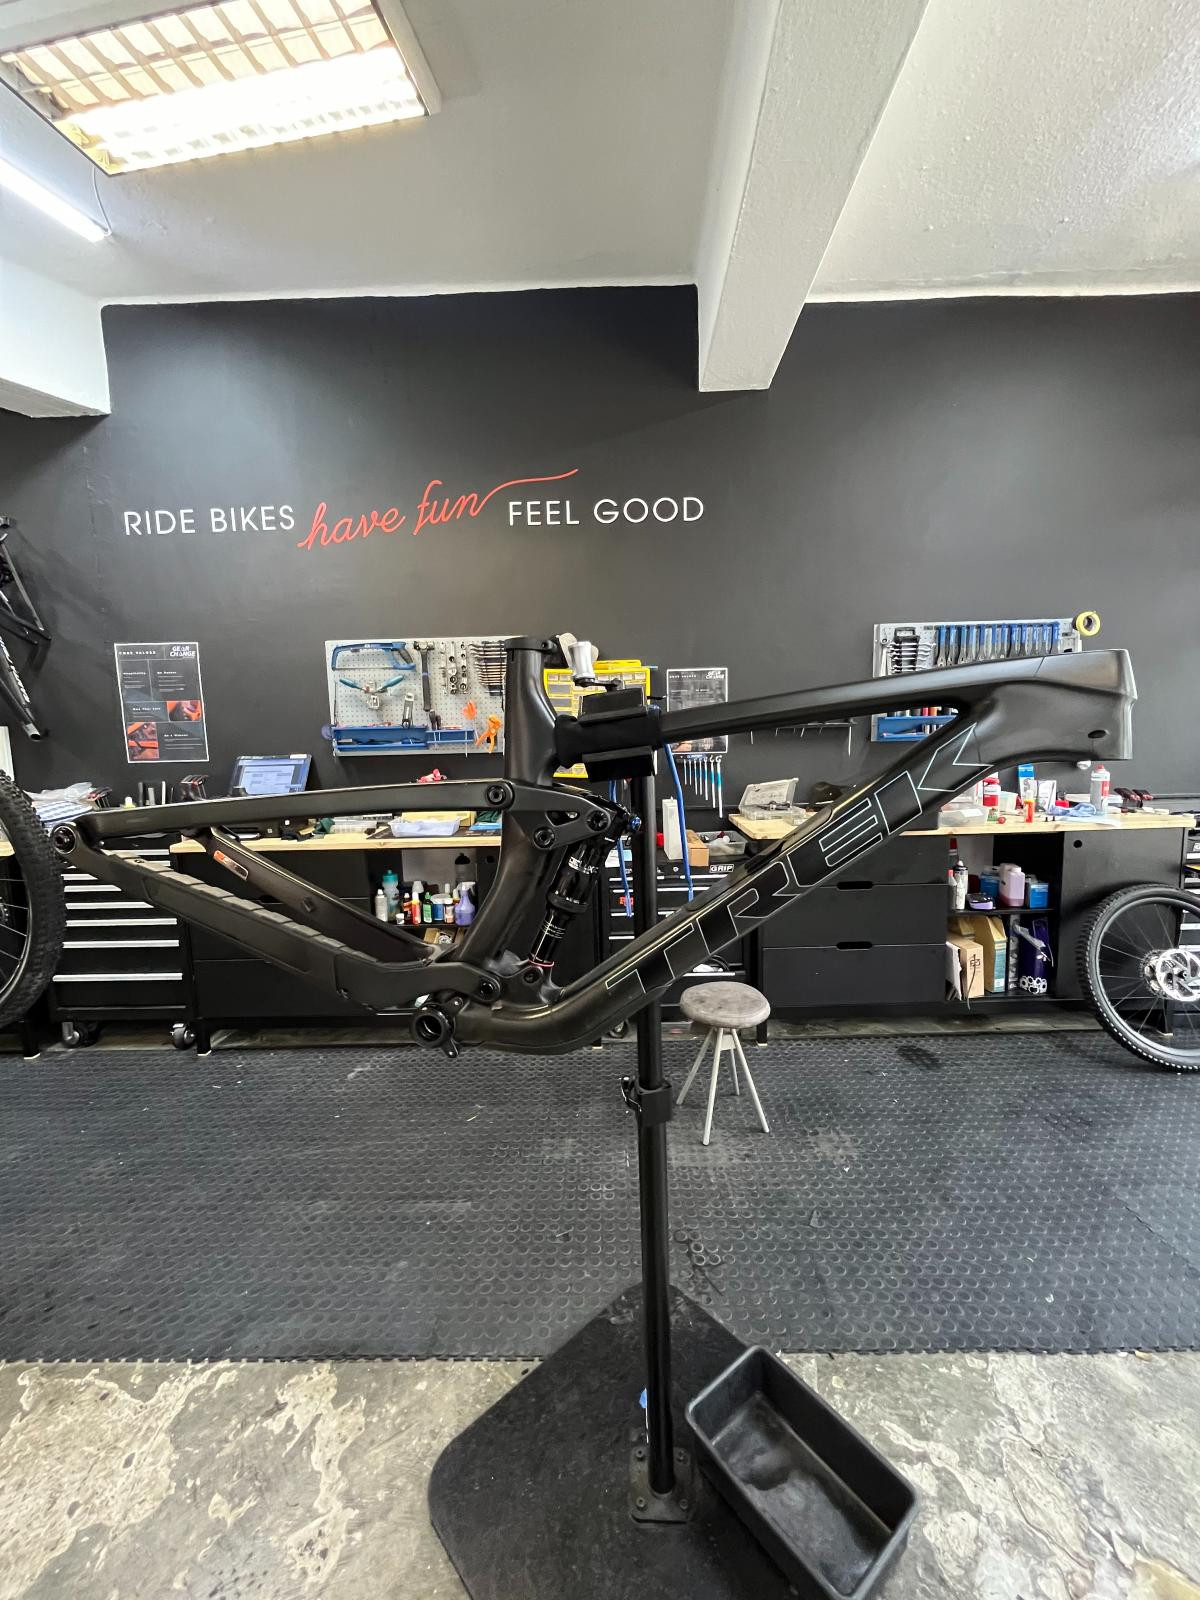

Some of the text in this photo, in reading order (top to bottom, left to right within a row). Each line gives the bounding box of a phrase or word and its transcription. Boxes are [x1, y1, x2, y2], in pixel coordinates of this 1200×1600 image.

[124, 510, 195, 535] RIDE
[210, 504, 295, 533] BIKES
[297, 503, 405, 548] have
[509, 501, 579, 526] FEEL
[594, 497, 703, 523] GOOD
[605, 722, 994, 994] TREK
[711, 864, 733, 872] GRIP
